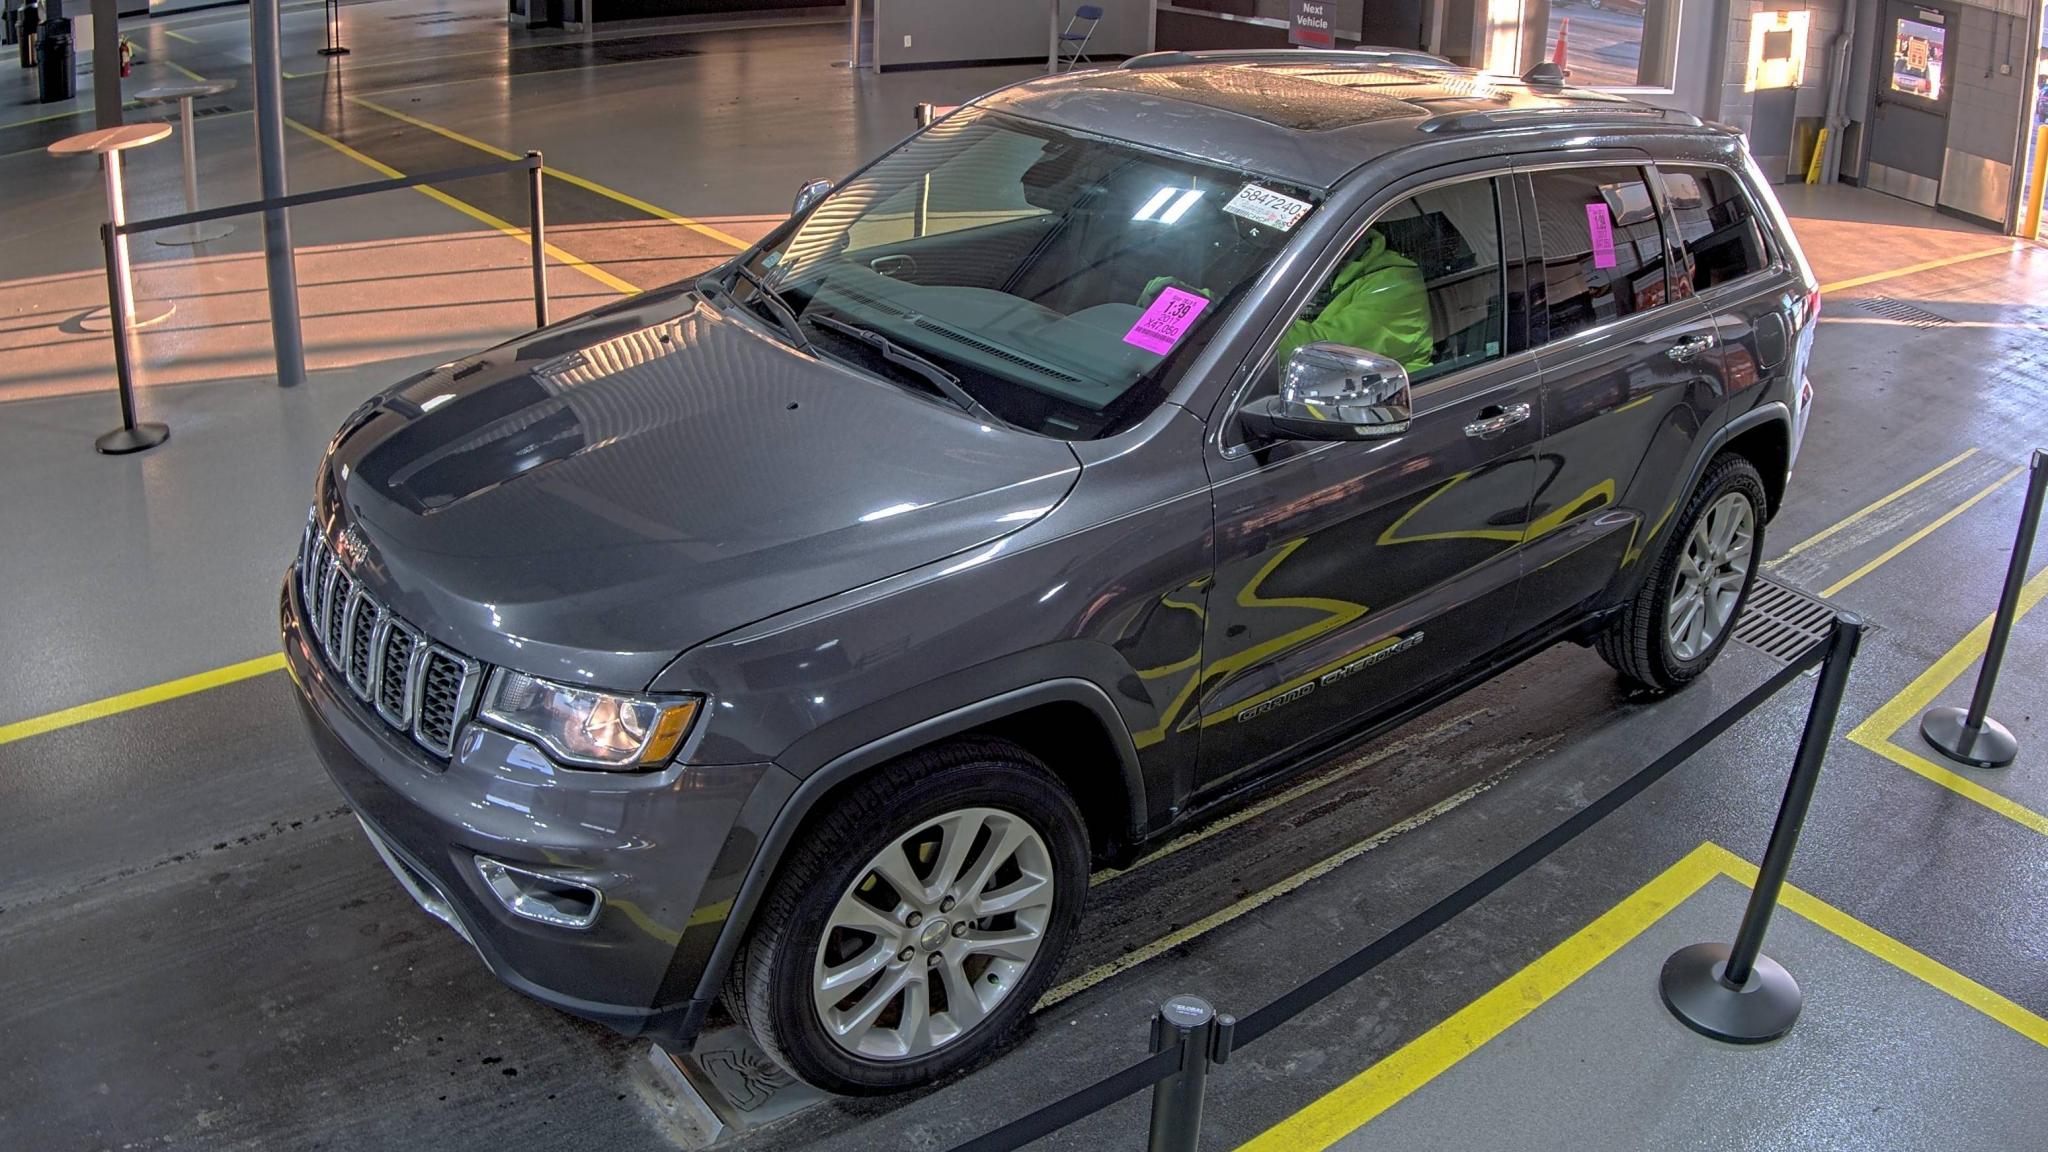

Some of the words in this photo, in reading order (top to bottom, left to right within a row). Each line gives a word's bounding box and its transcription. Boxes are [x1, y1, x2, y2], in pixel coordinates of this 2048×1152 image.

[1303, 3, 1323, 15] Next
[1297, 15, 1328, 29] Vehicle
[1240, 187, 1302, 215] 5847240
[1163, 300, 1191, 318] 1:39
[1157, 314, 1180, 325] 2017
[1238, 682, 1315, 723] GRAND
[1321, 631, 1425, 687] CHEROKEE
